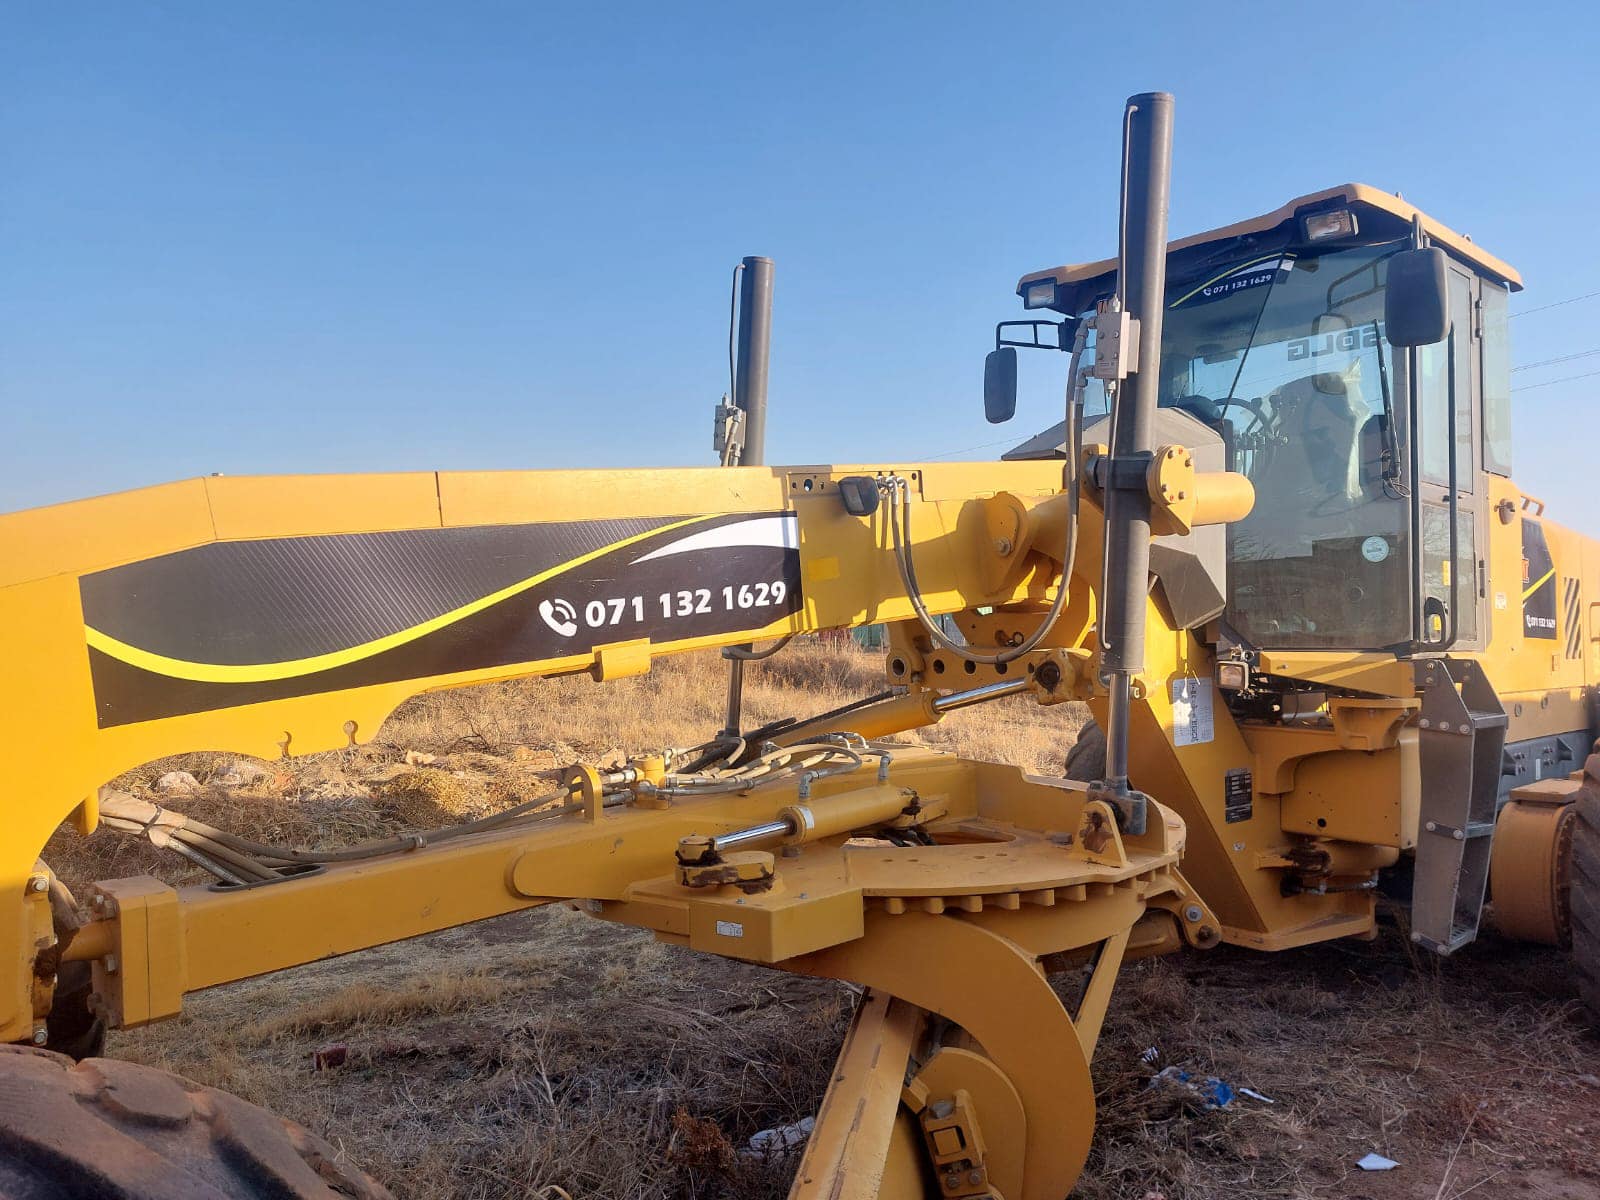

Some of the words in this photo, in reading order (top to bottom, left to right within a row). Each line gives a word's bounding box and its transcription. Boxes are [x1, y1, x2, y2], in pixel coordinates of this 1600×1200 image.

[1213, 284, 1229, 294] 071
[1232, 279, 1247, 290] 132
[1250, 274, 1272, 286] 1629
[584, 595, 645, 628] 071
[659, 588, 713, 619] 132
[721, 580, 787, 611] 1629
